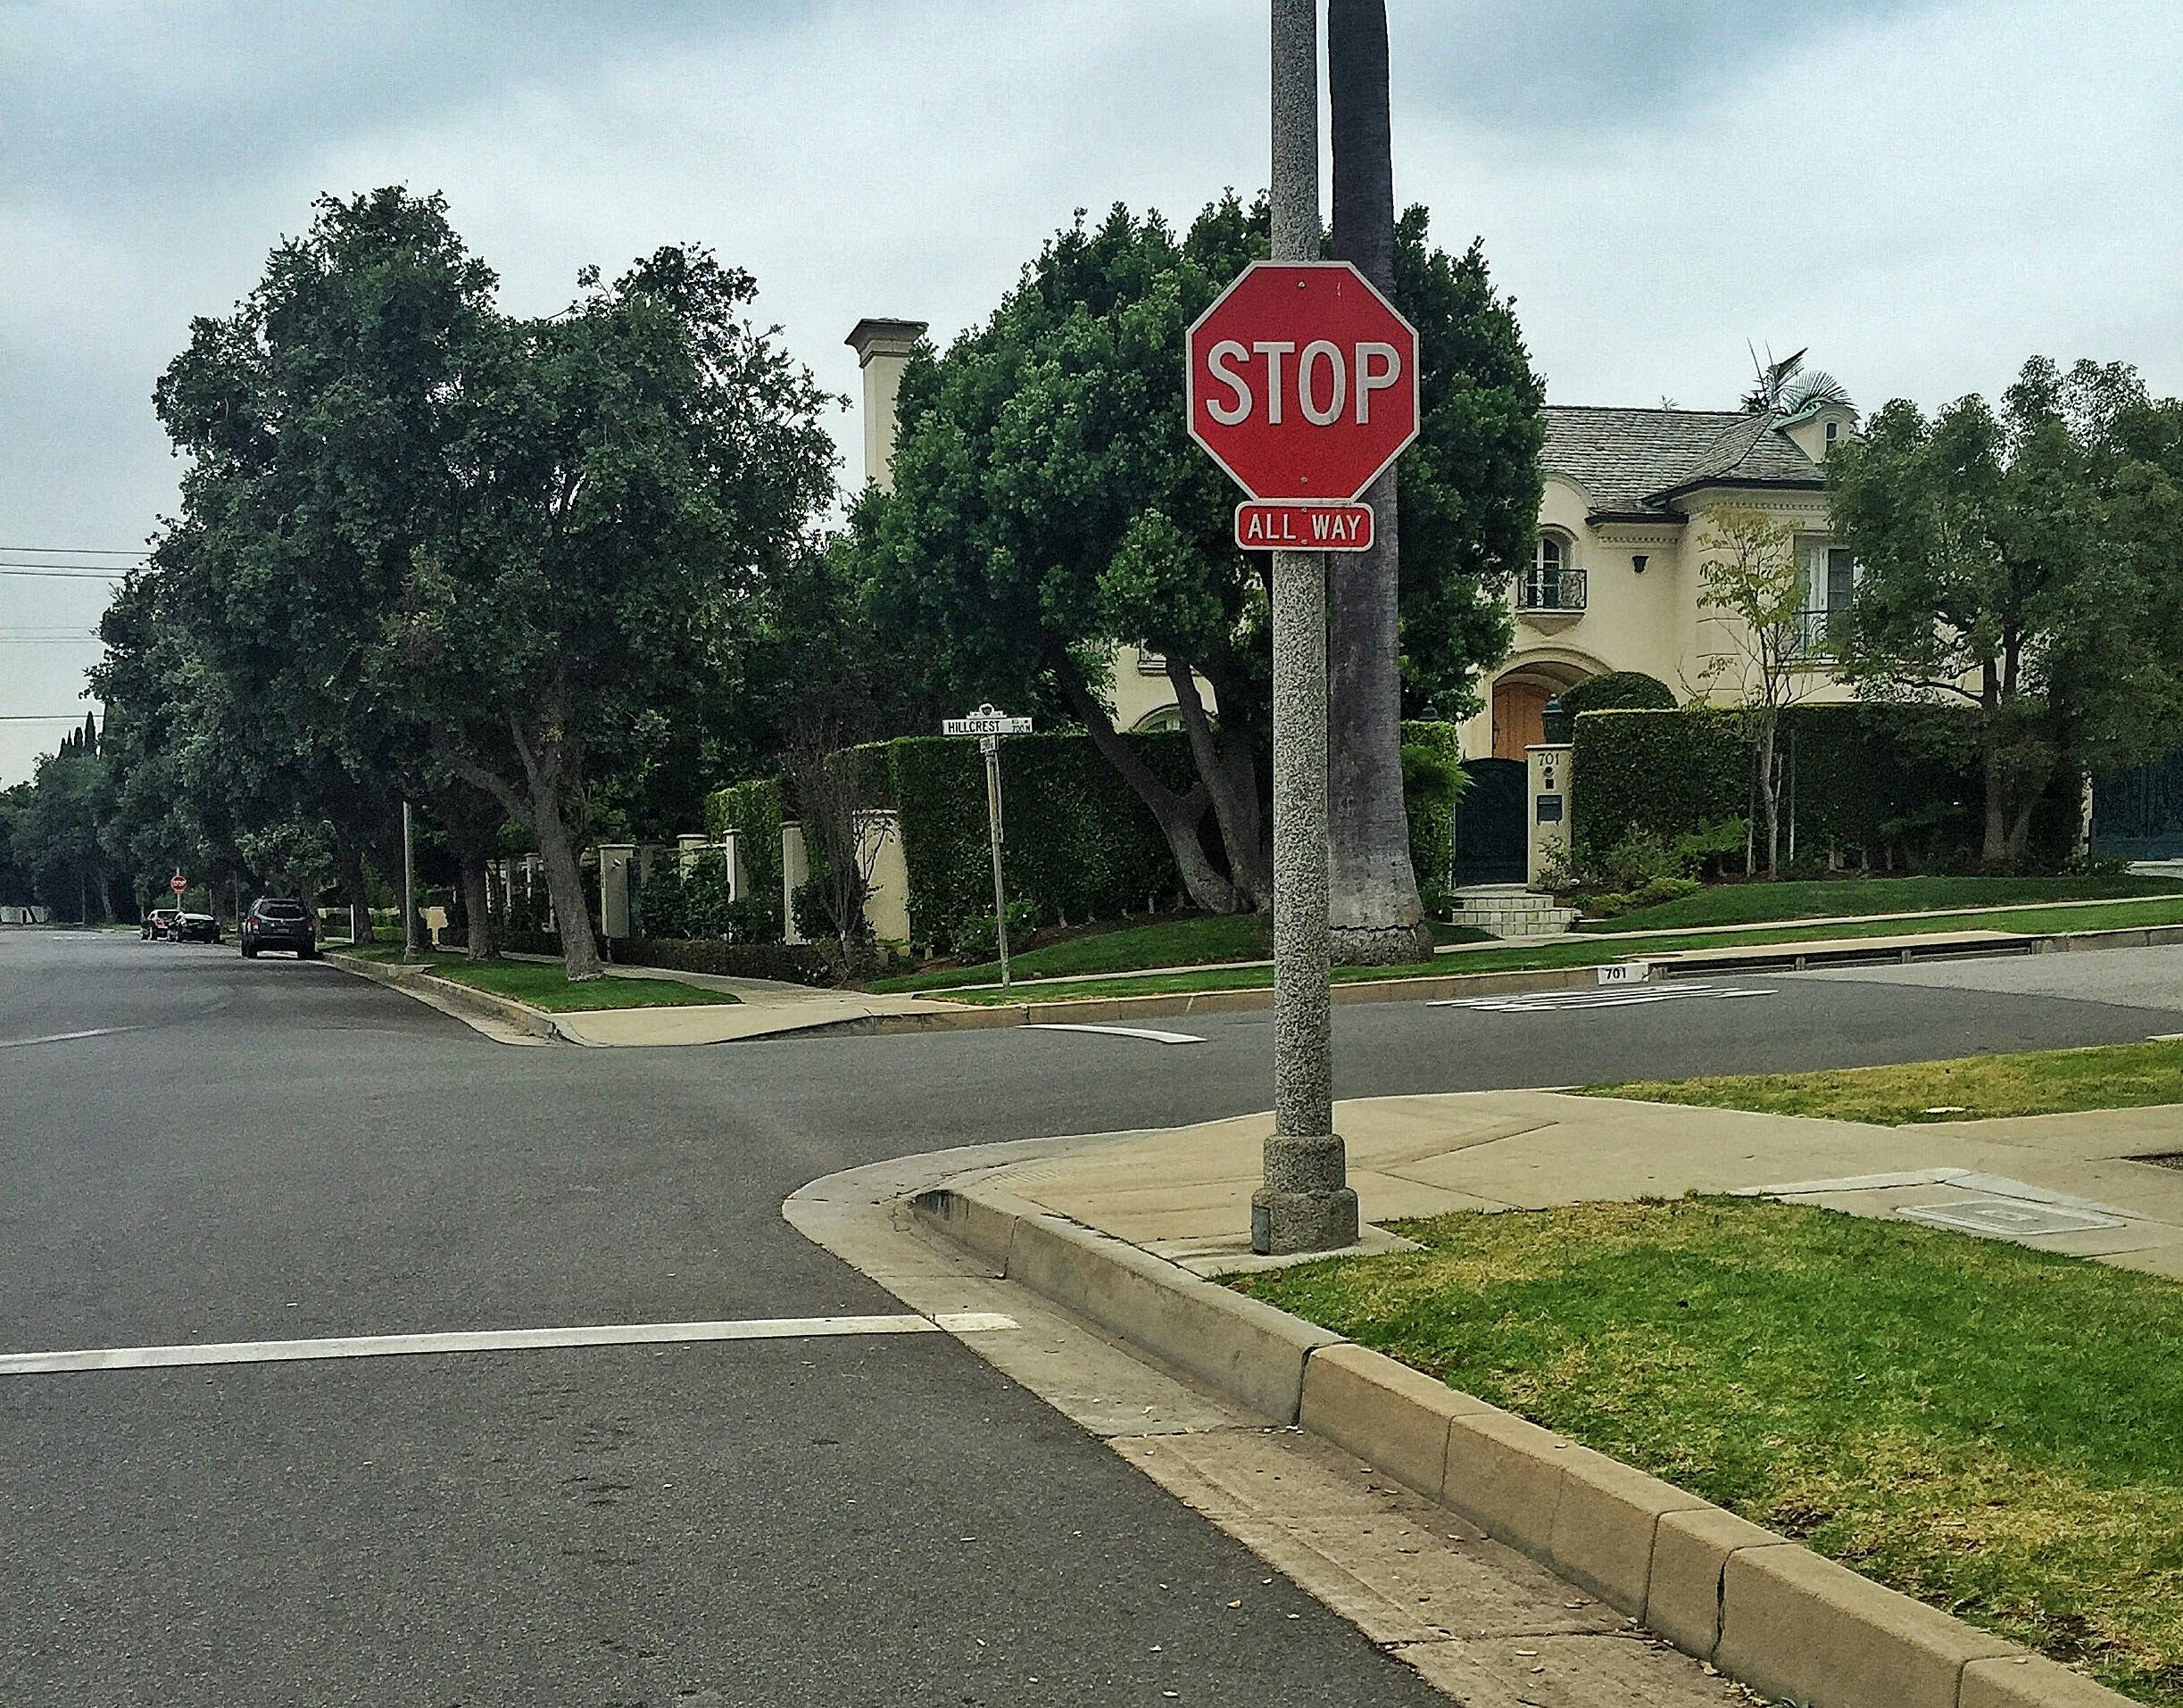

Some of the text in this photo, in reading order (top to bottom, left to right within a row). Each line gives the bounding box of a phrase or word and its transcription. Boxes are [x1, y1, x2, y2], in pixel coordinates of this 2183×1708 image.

[1206, 339, 1401, 426] STOP
[1247, 513, 1362, 541] ALL WAY
[948, 720, 1000, 734] HILLCREST
[1538, 752, 1559, 766] 701
[1605, 966, 1627, 980] 701
